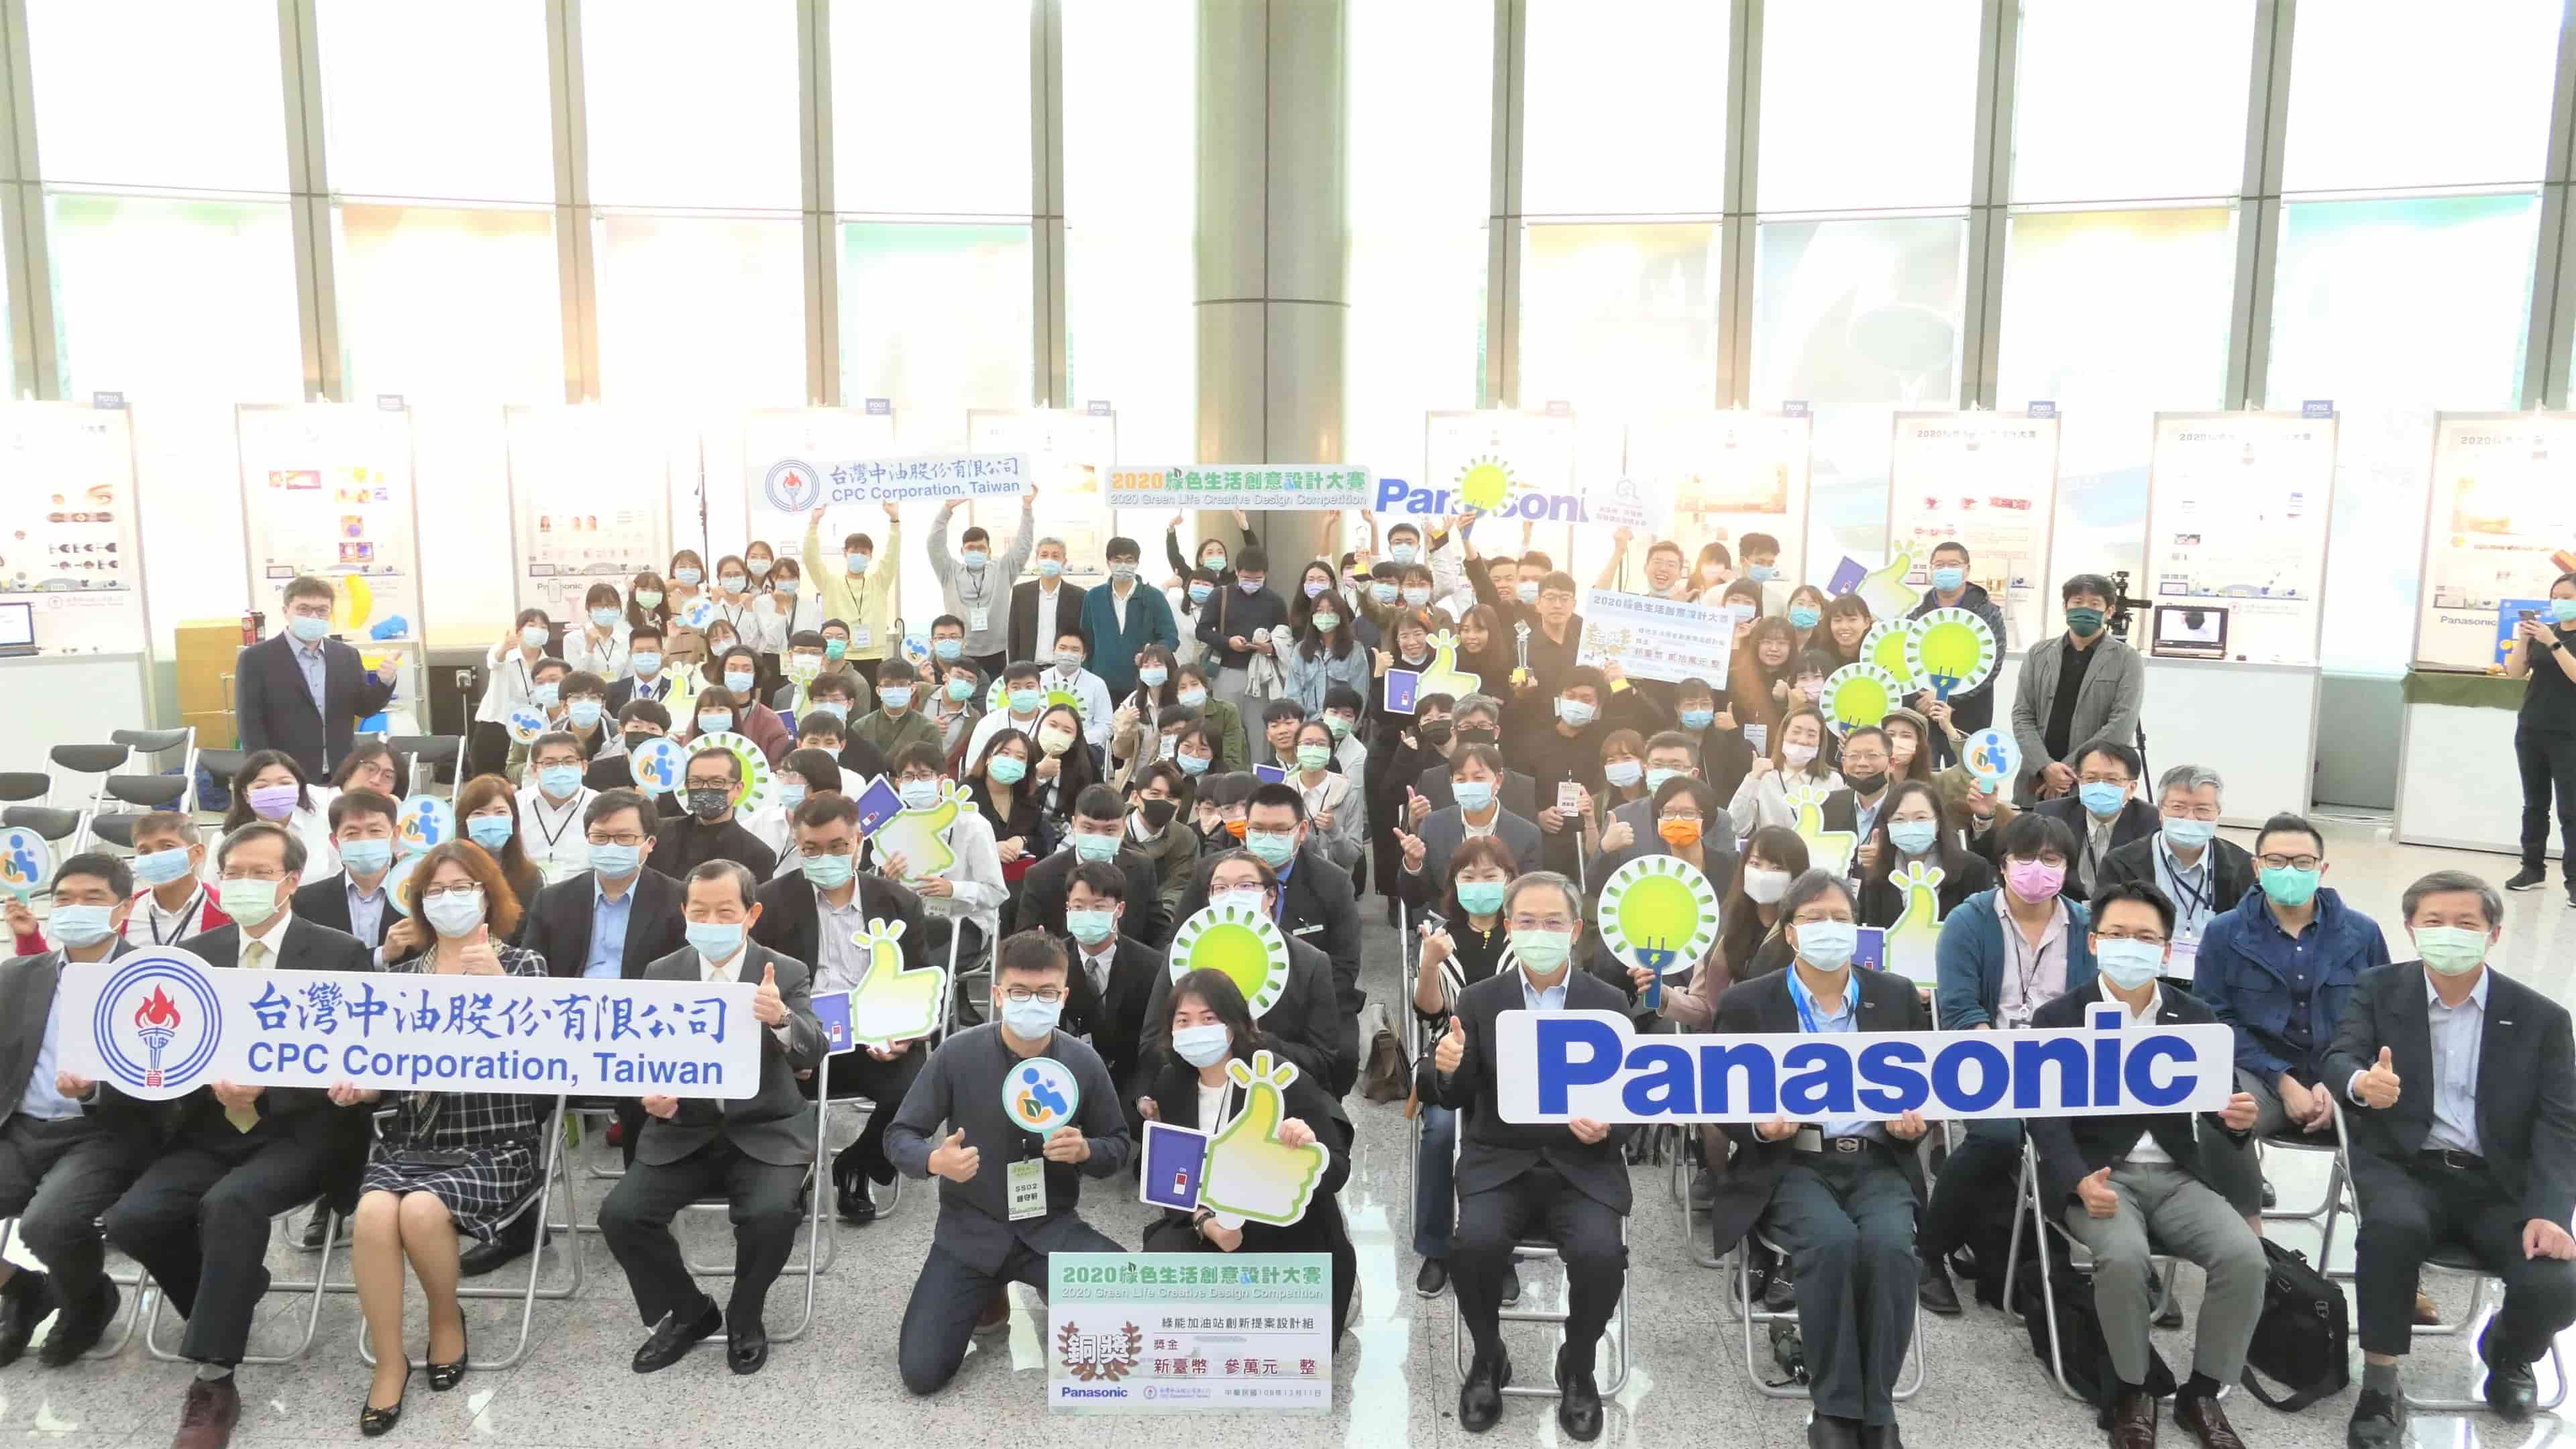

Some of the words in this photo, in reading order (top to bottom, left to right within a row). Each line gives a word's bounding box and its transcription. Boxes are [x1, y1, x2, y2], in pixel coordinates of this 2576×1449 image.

[829, 456, 1019, 486] 台灣中油股份有限公司
[832, 488, 865, 502] CPC
[871, 483, 965, 502] Corporation,
[970, 480, 1020, 494] Taiwan
[1110, 494, 1138, 505] 2020
[1142, 494, 1175, 505] Green
[1179, 494, 1200, 505] Life
[1204, 494, 1250, 505] Creative
[1254, 494, 1293, 507] Design
[1297, 494, 1368, 508] Competition
[2440, 615, 2496, 627] Panasonic
[250, 980, 727, 1043] 台灣中油股份有限公司
[248, 1041, 329, 1074] CPC
[343, 1043, 579, 1087] Corporation,
[593, 1052, 723, 1085] Taiwan
[1536, 1011, 2198, 1116] Panasonic
[1063, 1265, 1322, 1284] 2020綠色生活創意設計大賽
[1063, 1287, 1091, 1299] 2020
[1095, 1287, 1128, 1299] Green
[1132, 1287, 1155, 1299] Life
[1159, 1287, 1206, 1299] Creative
[1210, 1287, 1249, 1300] Design
[1253, 1287, 1323, 1301] Competition
[1067, 1334, 1129, 1364] 銅獎
[1154, 1358, 1208, 1375] 新臺幣
[1224, 1358, 1278, 1375] 參萬元
[1300, 1358, 1316, 1375] 整
[1061, 1386, 1128, 1397] Panasonic
